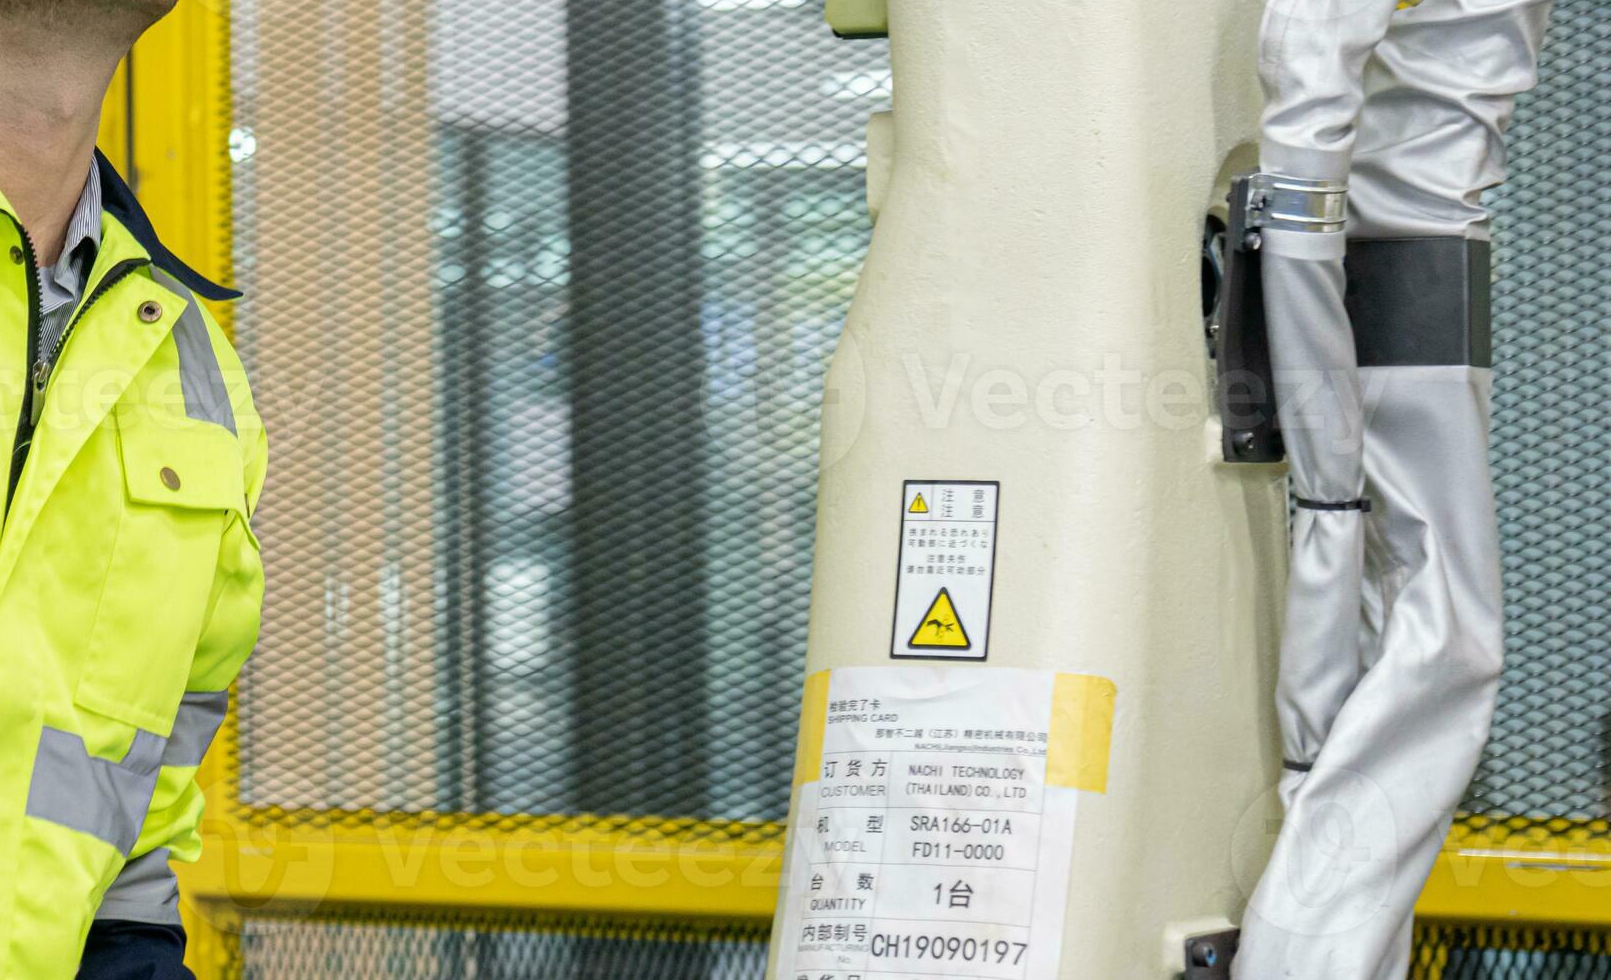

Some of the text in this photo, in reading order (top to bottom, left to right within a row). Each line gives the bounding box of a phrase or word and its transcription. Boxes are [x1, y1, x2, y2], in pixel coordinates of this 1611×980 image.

[870, 714, 899, 723] CARD
[908, 765, 1026, 780] NACHI TECHNOLOGY
[821, 784, 886, 798] CUSTOMER
[910, 816, 1012, 835] SRA166-01A
[824, 841, 867, 853] MODEL
[912, 842, 1005, 860] FD11-0000
[810, 898, 866, 911] QUANTITY
[871, 934, 1029, 966] CH19090197
